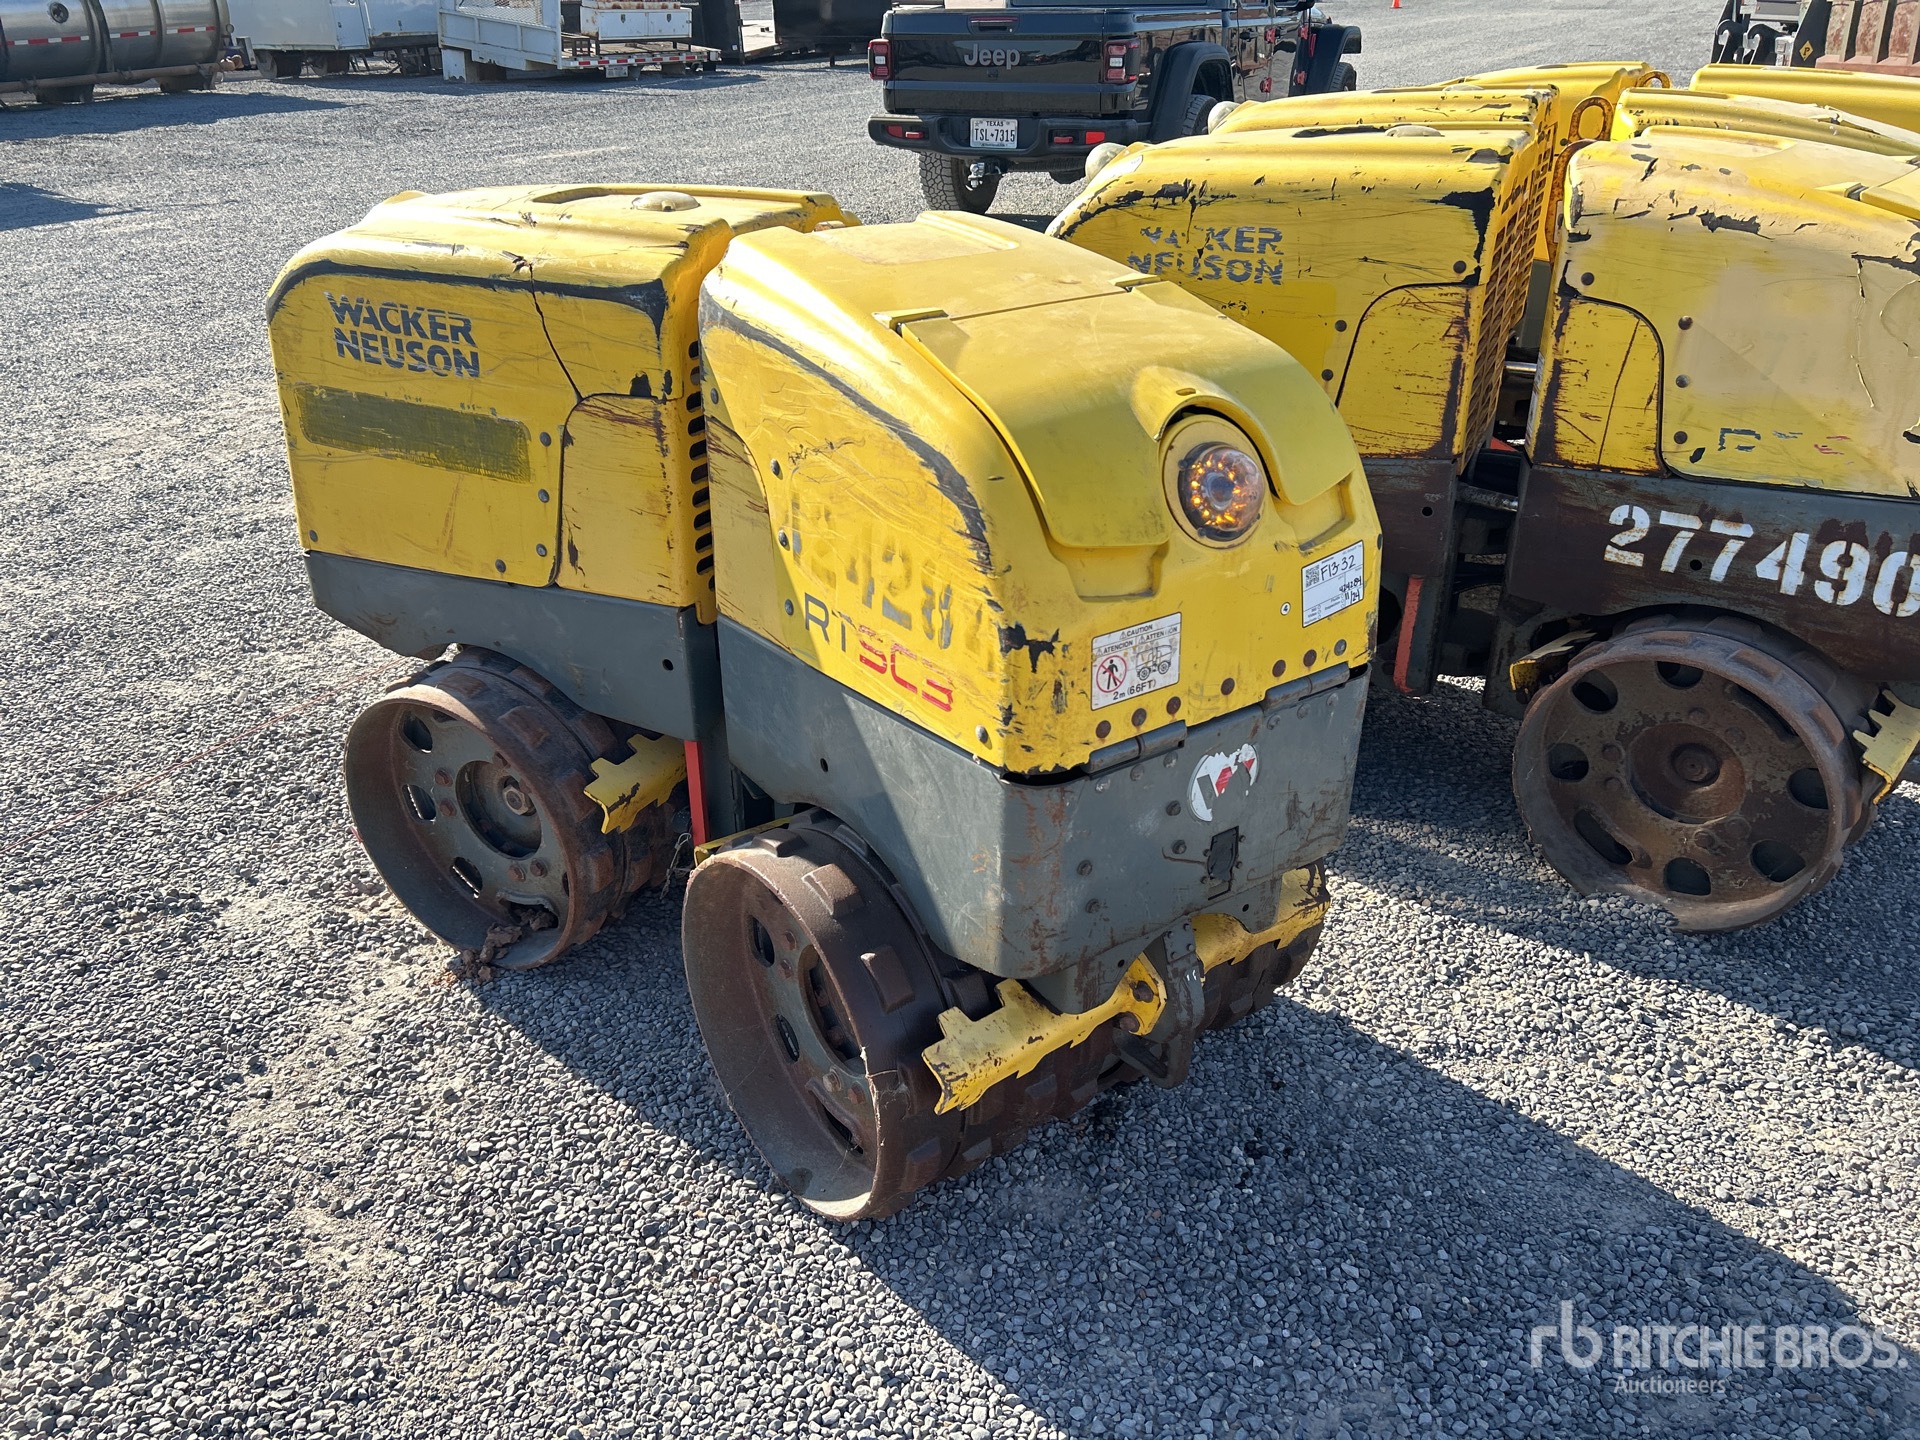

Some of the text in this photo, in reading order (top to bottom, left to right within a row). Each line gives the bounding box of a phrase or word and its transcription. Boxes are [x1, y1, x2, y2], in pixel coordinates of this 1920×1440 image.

[964, 43, 1021, 70] Jeep
[323, 291, 478, 348] WACKER
[333, 327, 480, 378] NEUSON
[1603, 503, 1920, 618] 277490
[1126, 624, 1153, 637] CAUTION
